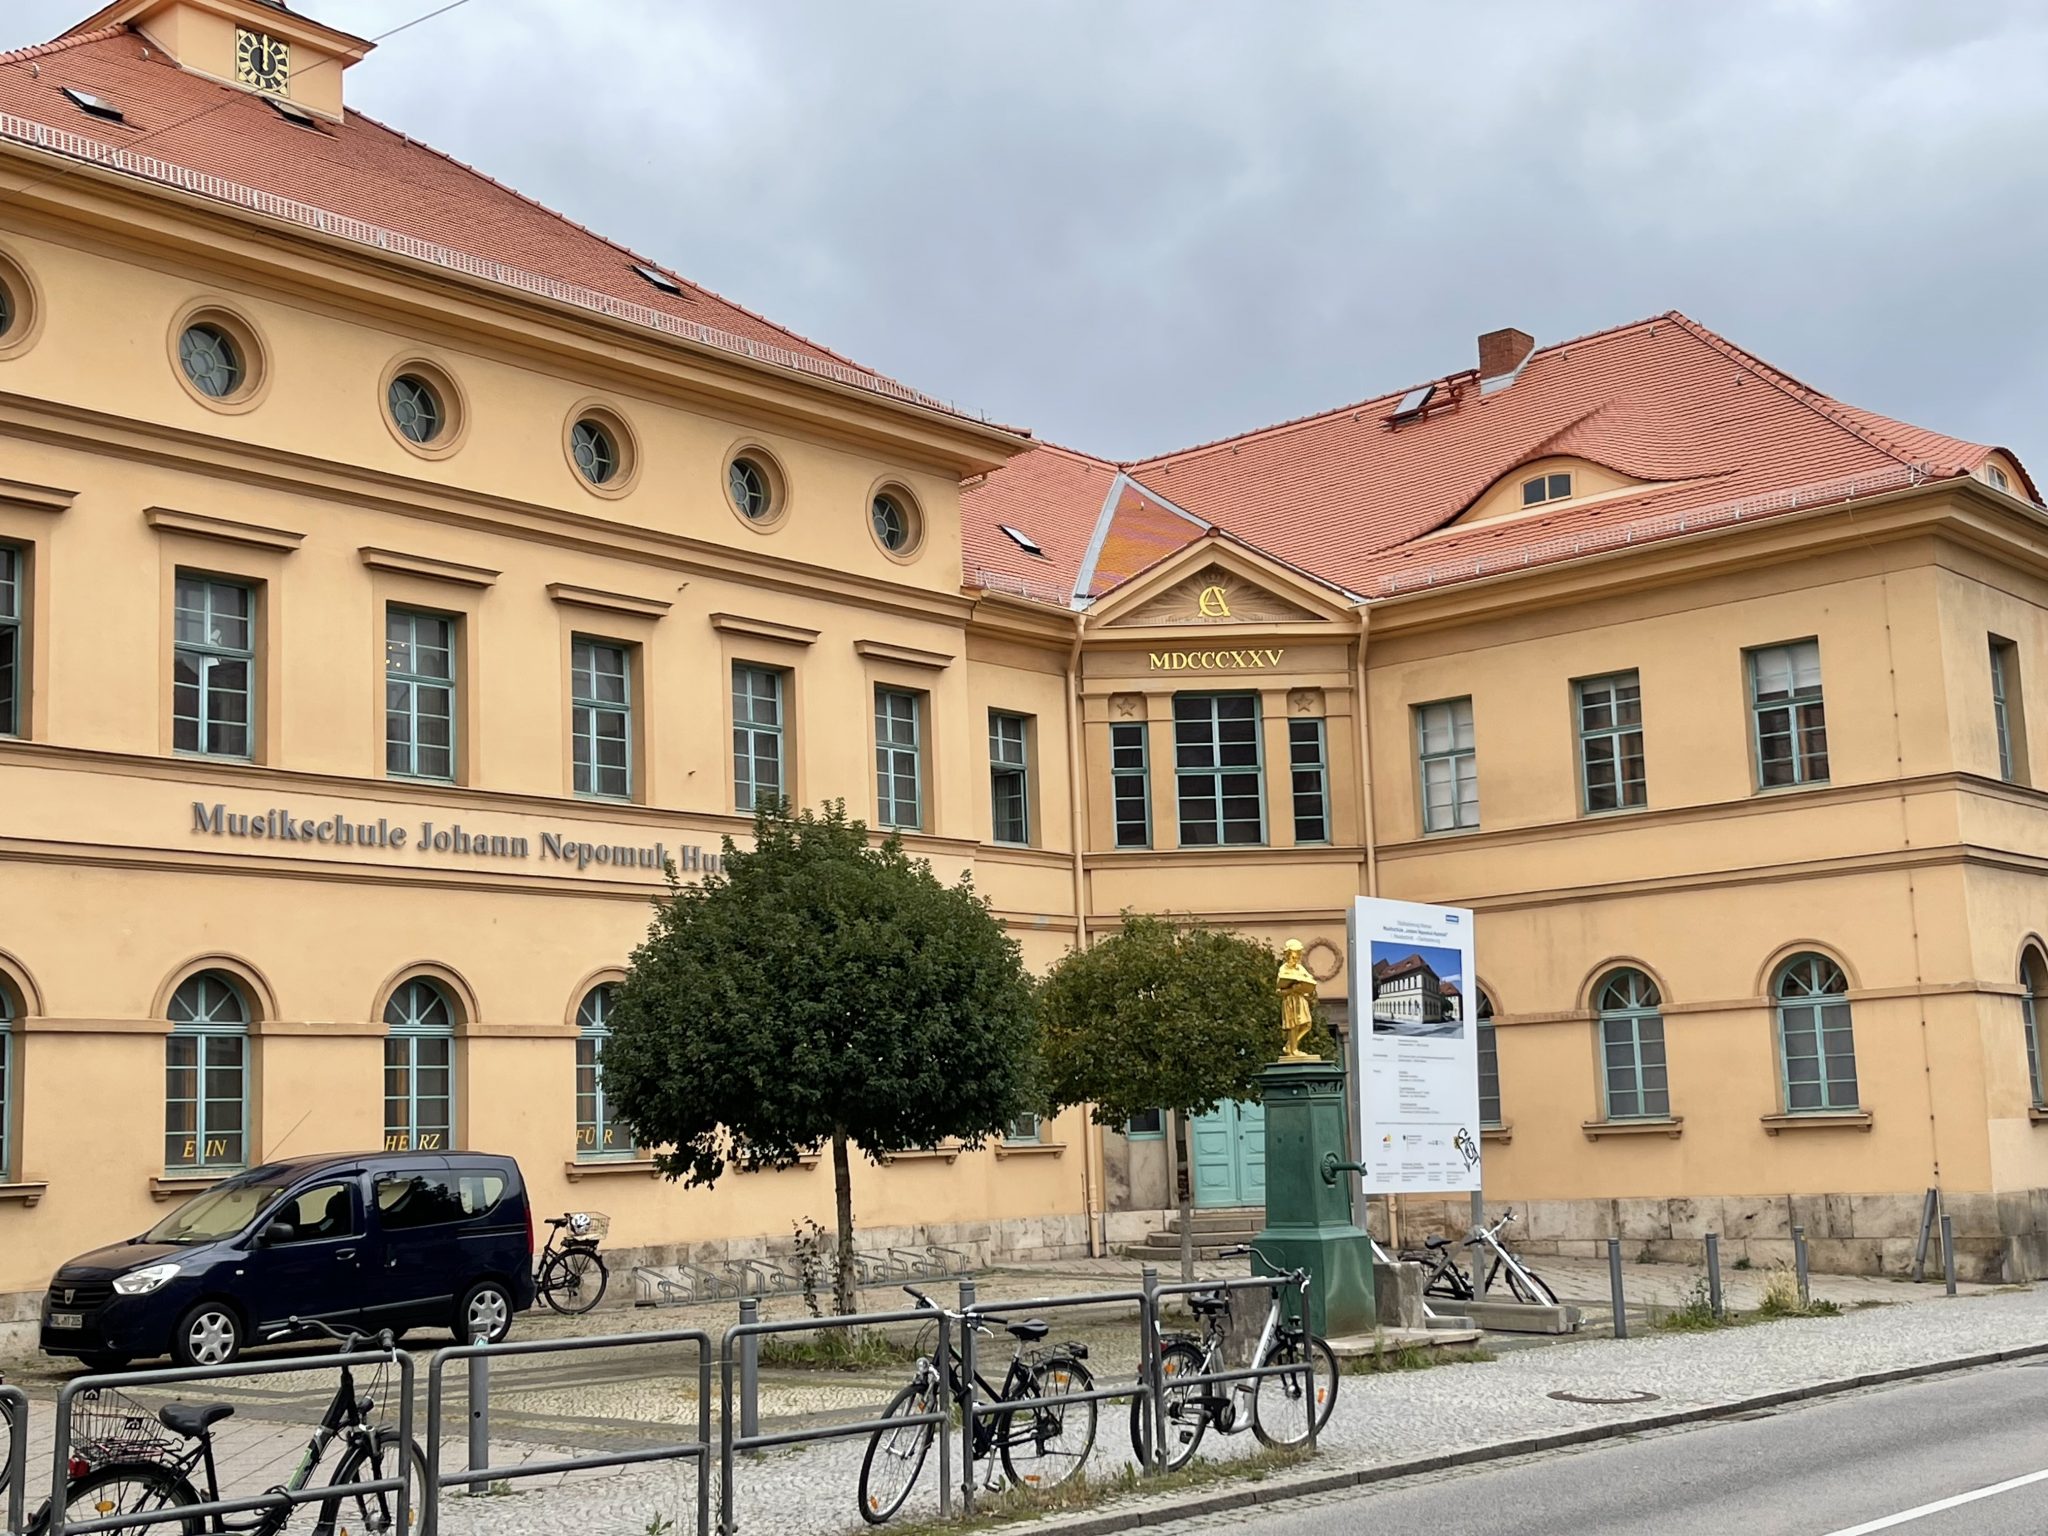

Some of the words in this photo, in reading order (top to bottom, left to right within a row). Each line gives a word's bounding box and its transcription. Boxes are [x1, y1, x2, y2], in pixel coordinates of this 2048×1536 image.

[1148, 649, 1284, 671] MDCCCXXV
[191, 801, 407, 848] Musikschule
[417, 821, 529, 858] Johann
[540, 831, 669, 870] Nepomuk
[384, 1133, 440, 1152] HERZ
[576, 1126, 613, 1145] FÜR
[182, 1139, 227, 1158] EIN
